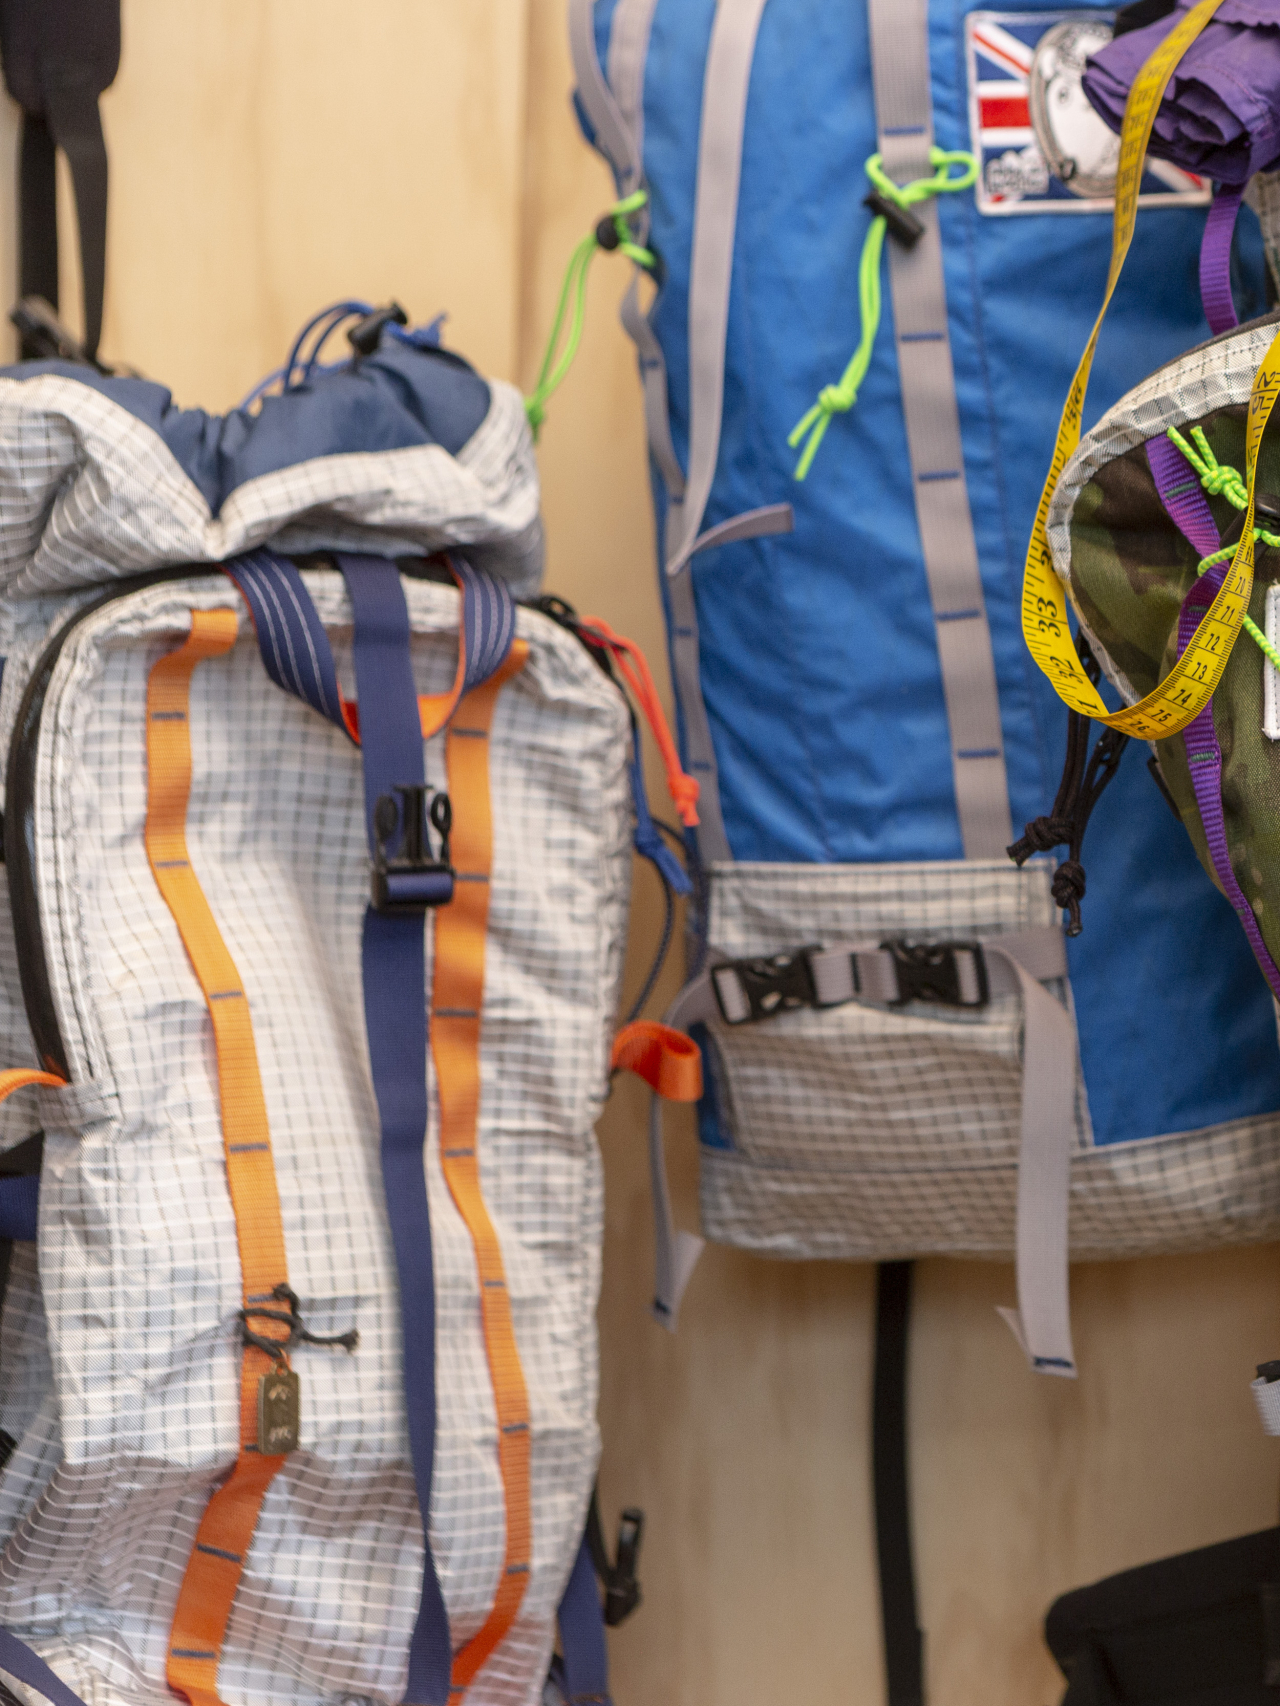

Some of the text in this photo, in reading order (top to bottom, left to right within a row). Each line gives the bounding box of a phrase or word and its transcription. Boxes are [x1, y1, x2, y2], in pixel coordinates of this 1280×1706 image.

[1252, 370, 1276, 415] 25
[1036, 596, 1062, 639] 33
[1219, 604, 1234, 623] 71
[1206, 632, 1221, 652] 72
[1190, 661, 1208, 681] 73
[1172, 688, 1193, 706] 74
[1129, 717, 1150, 732] 76
[1151, 708, 1172, 723] 75
